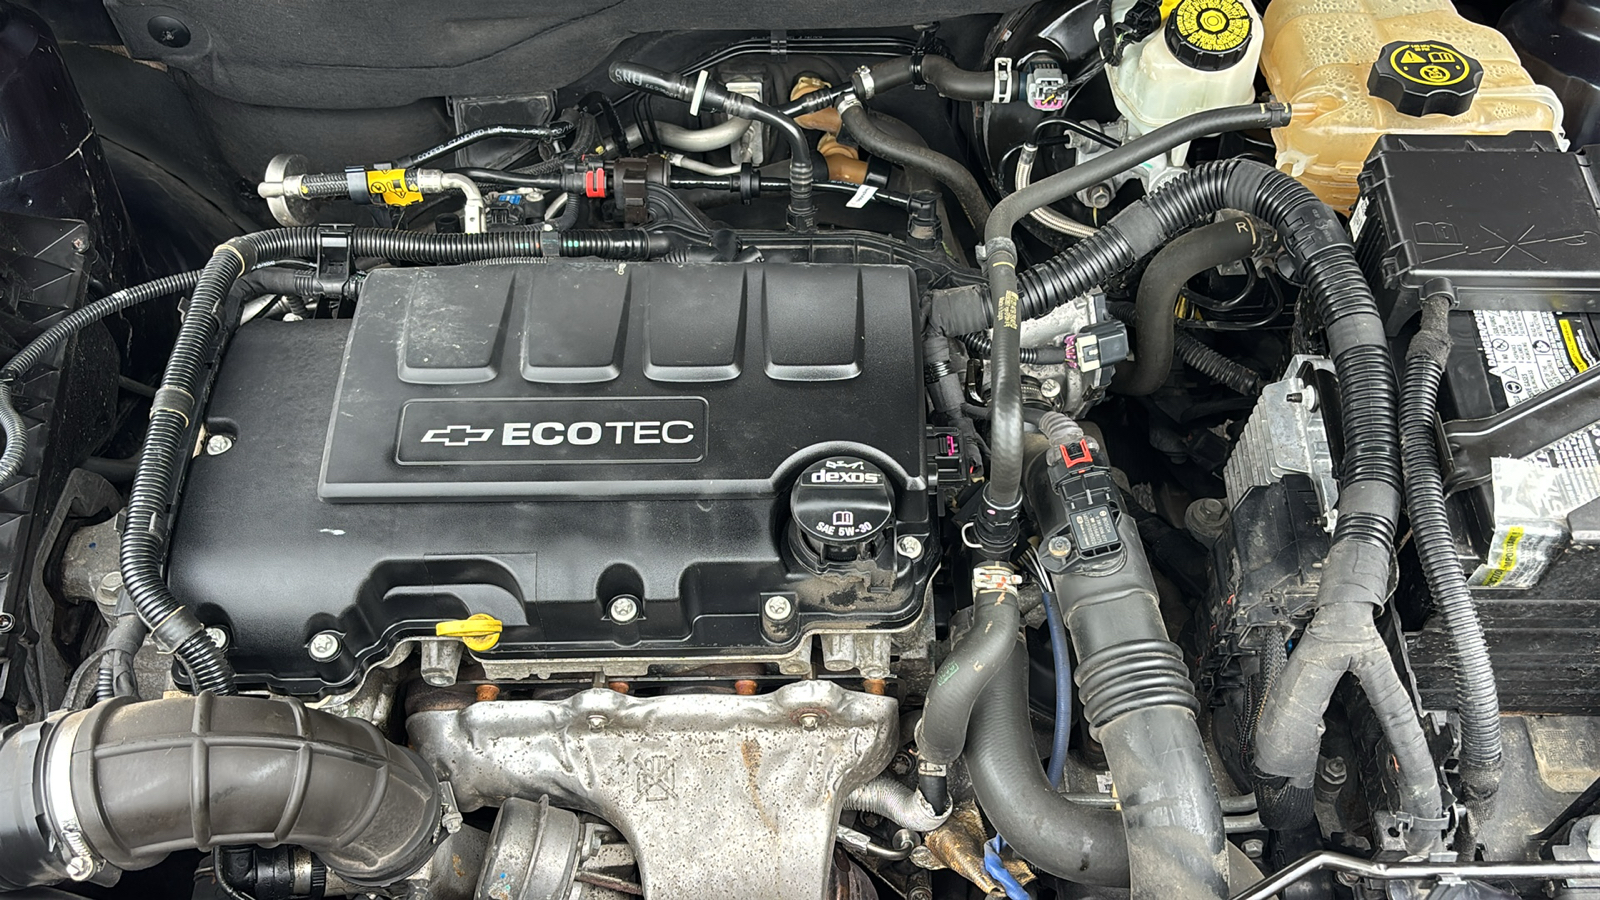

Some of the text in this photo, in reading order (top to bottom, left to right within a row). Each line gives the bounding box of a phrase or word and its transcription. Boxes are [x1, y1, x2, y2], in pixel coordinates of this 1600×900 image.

[1235, 221, 1249, 234] R
[501, 420, 695, 446] ECOTEC
[811, 469, 879, 484] dexos
[816, 521, 873, 537] SAE 5W-30
